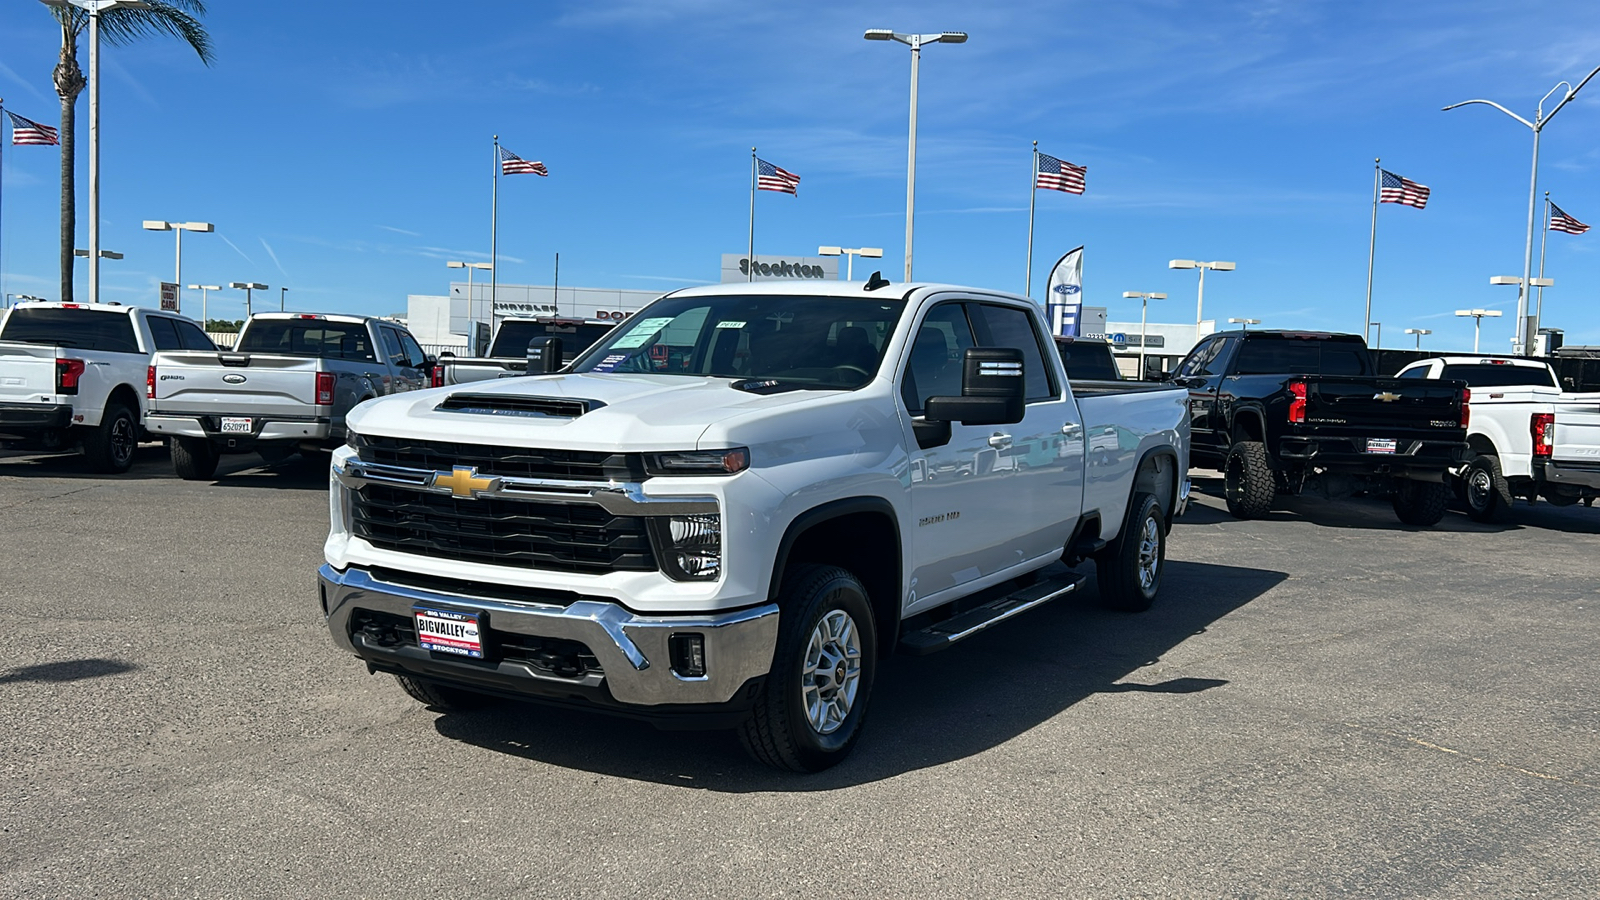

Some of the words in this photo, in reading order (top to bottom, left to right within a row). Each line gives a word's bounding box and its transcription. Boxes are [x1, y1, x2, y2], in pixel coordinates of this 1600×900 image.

[739, 258, 825, 278] Stockton
[1058, 285, 1077, 294] Ford
[163, 292, 174, 300] USED
[162, 300, 176, 309] CARS
[439, 612, 462, 620] VALLEY
[418, 618, 465, 638] BIGVALLEY
[432, 644, 469, 655] STOCKTON
